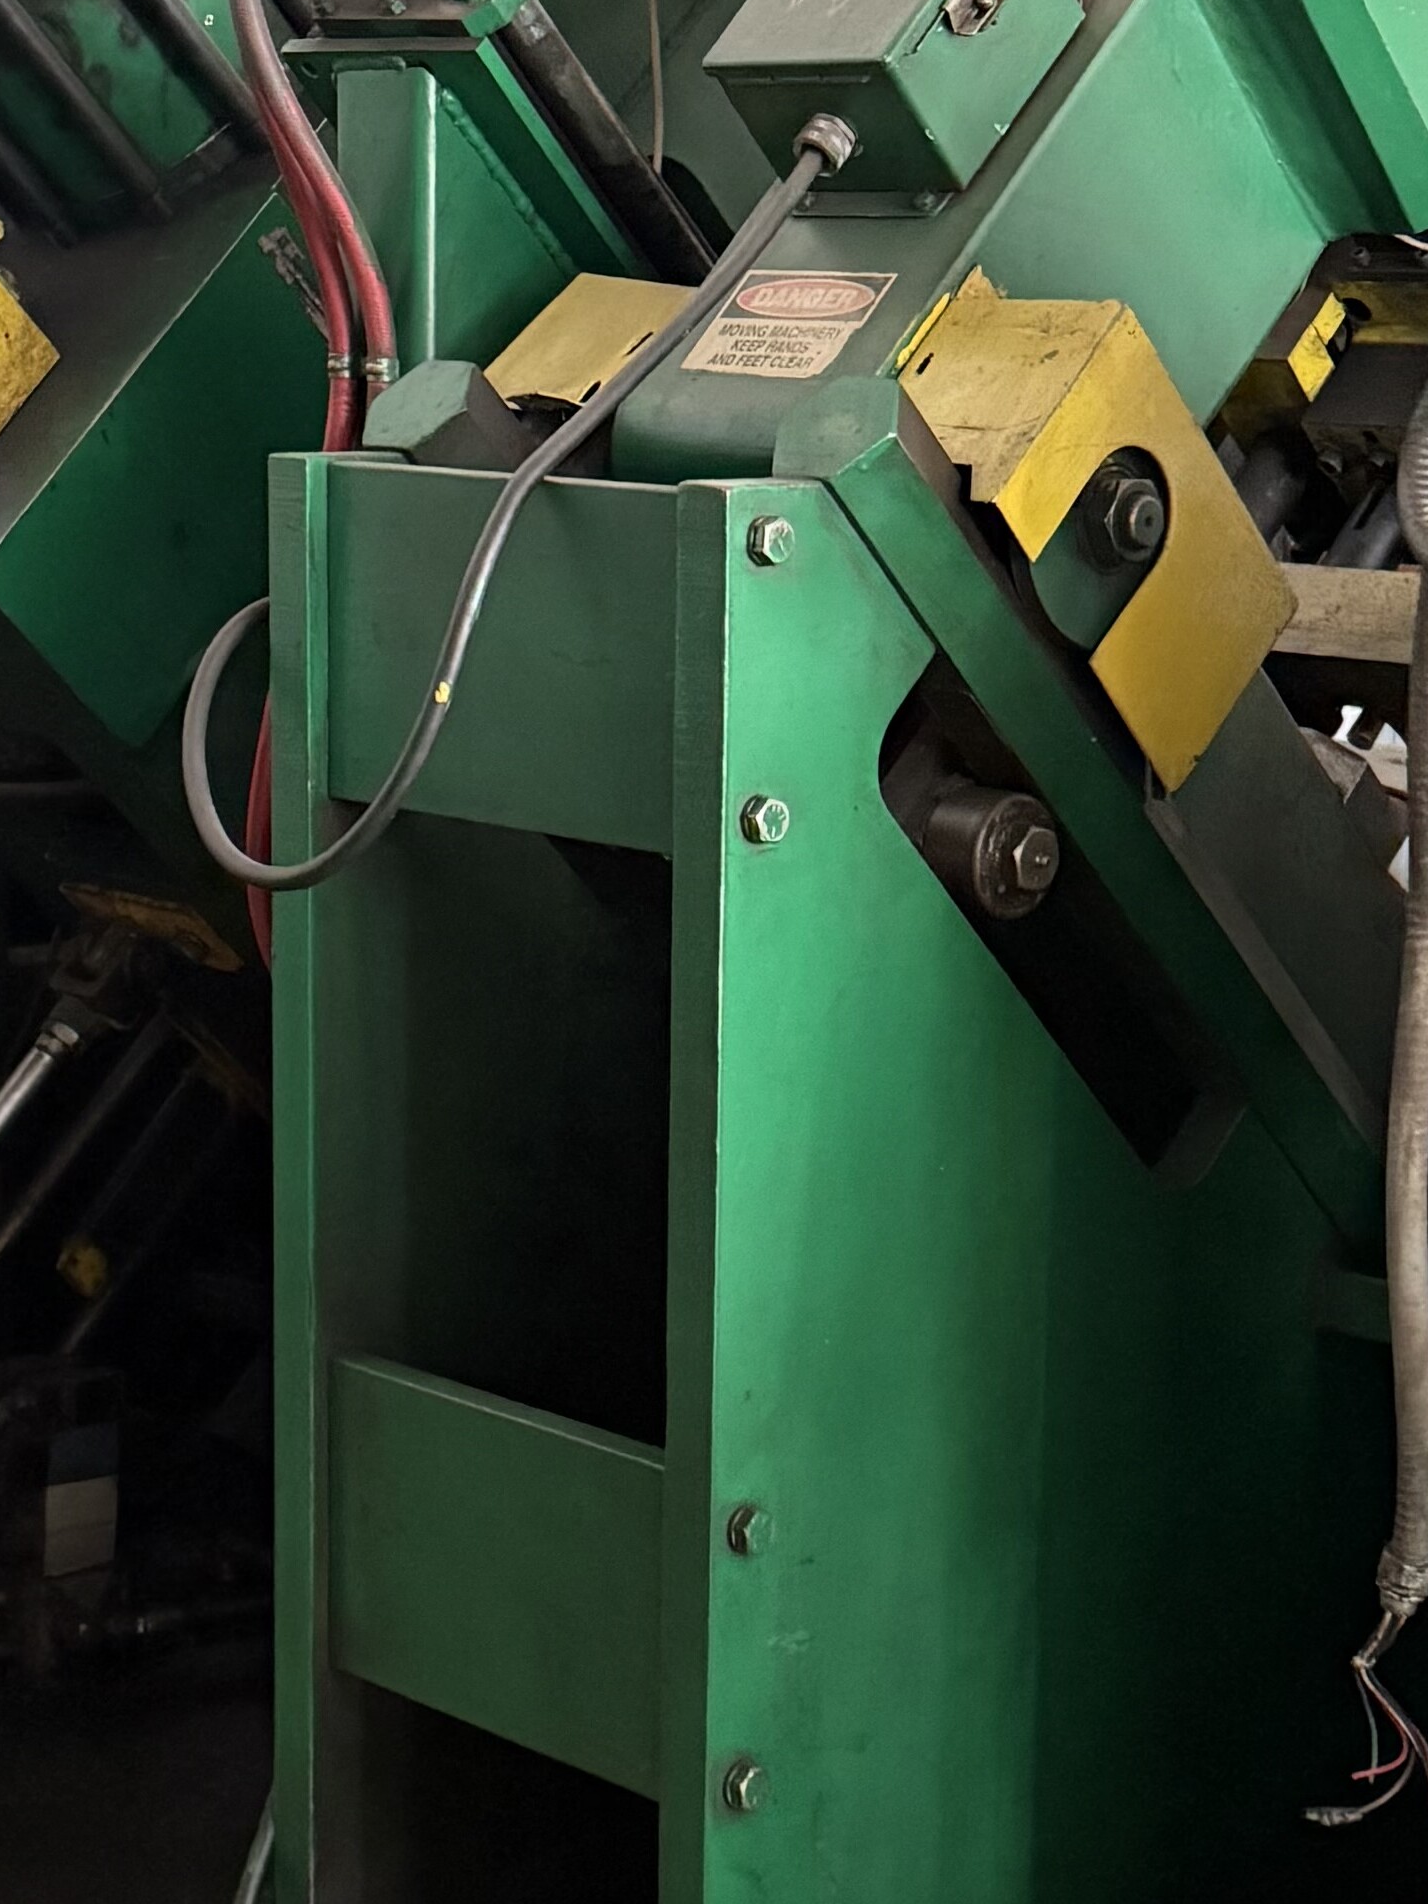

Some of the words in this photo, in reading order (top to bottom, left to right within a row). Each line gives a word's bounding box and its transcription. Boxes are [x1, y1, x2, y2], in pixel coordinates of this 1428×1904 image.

[749, 287, 859, 309] DANGER
[719, 324, 767, 338] MOVING
[770, 325, 845, 340] MACHINERY
[730, 339, 764, 353] KEEP
[765, 341, 811, 354] HANDS
[707, 353, 735, 365] AND
[735, 354, 769, 368] FEET
[769, 355, 814, 369] CLEAR
